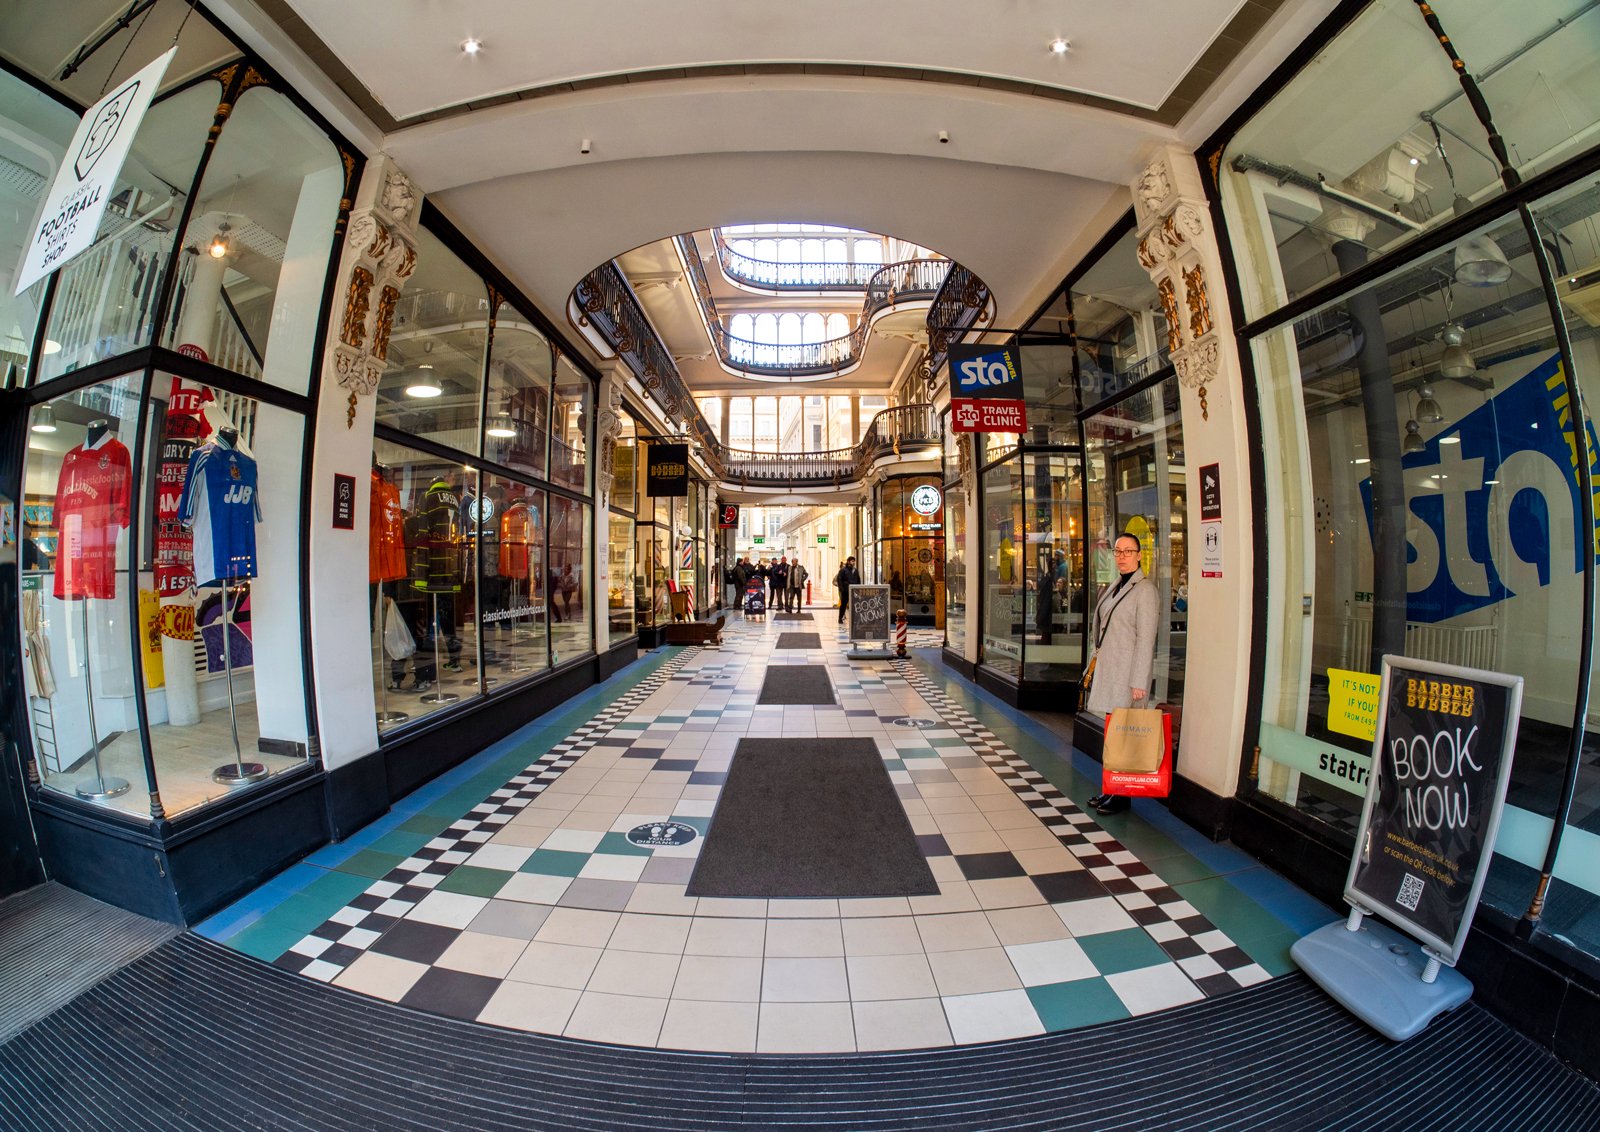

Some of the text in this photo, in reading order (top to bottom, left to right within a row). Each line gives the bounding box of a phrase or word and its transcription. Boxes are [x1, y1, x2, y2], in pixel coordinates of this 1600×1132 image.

[60, 178, 94, 209] CLASSIC
[38, 185, 101, 243] FOOTBALL
[45, 219, 78, 252] SHIRTS
[42, 242, 67, 268] SHOP
[961, 357, 1009, 385] sta
[1003, 351, 1017, 379] TRAVEL
[959, 410, 978, 420] sta
[982, 406, 1020, 415] TRAVEL
[983, 416, 1021, 426] CLINIC
[224, 485, 252, 504] JJB
[855, 596, 884, 613] BOOK
[1342, 680, 1376, 695] IT'S NOT
[1407, 678, 1475, 701] BARBER
[1348, 698, 1356, 707] IF
[1344, 712, 1360, 722] FROM
[1116, 725, 1152, 733] PRIMARK
[1391, 725, 1482, 780] BOOK
[1112, 776, 1159, 784] FOOTASYLUM.COM
[1405, 782, 1469, 830] NOW
[638, 822, 671, 830] PLEASE
[1384, 846, 1391, 854] or
[1390, 849, 1404, 861] scan
[1403, 855, 1414, 865] the
[1413, 859, 1423, 870] QR
[1422, 865, 1438, 878] code
